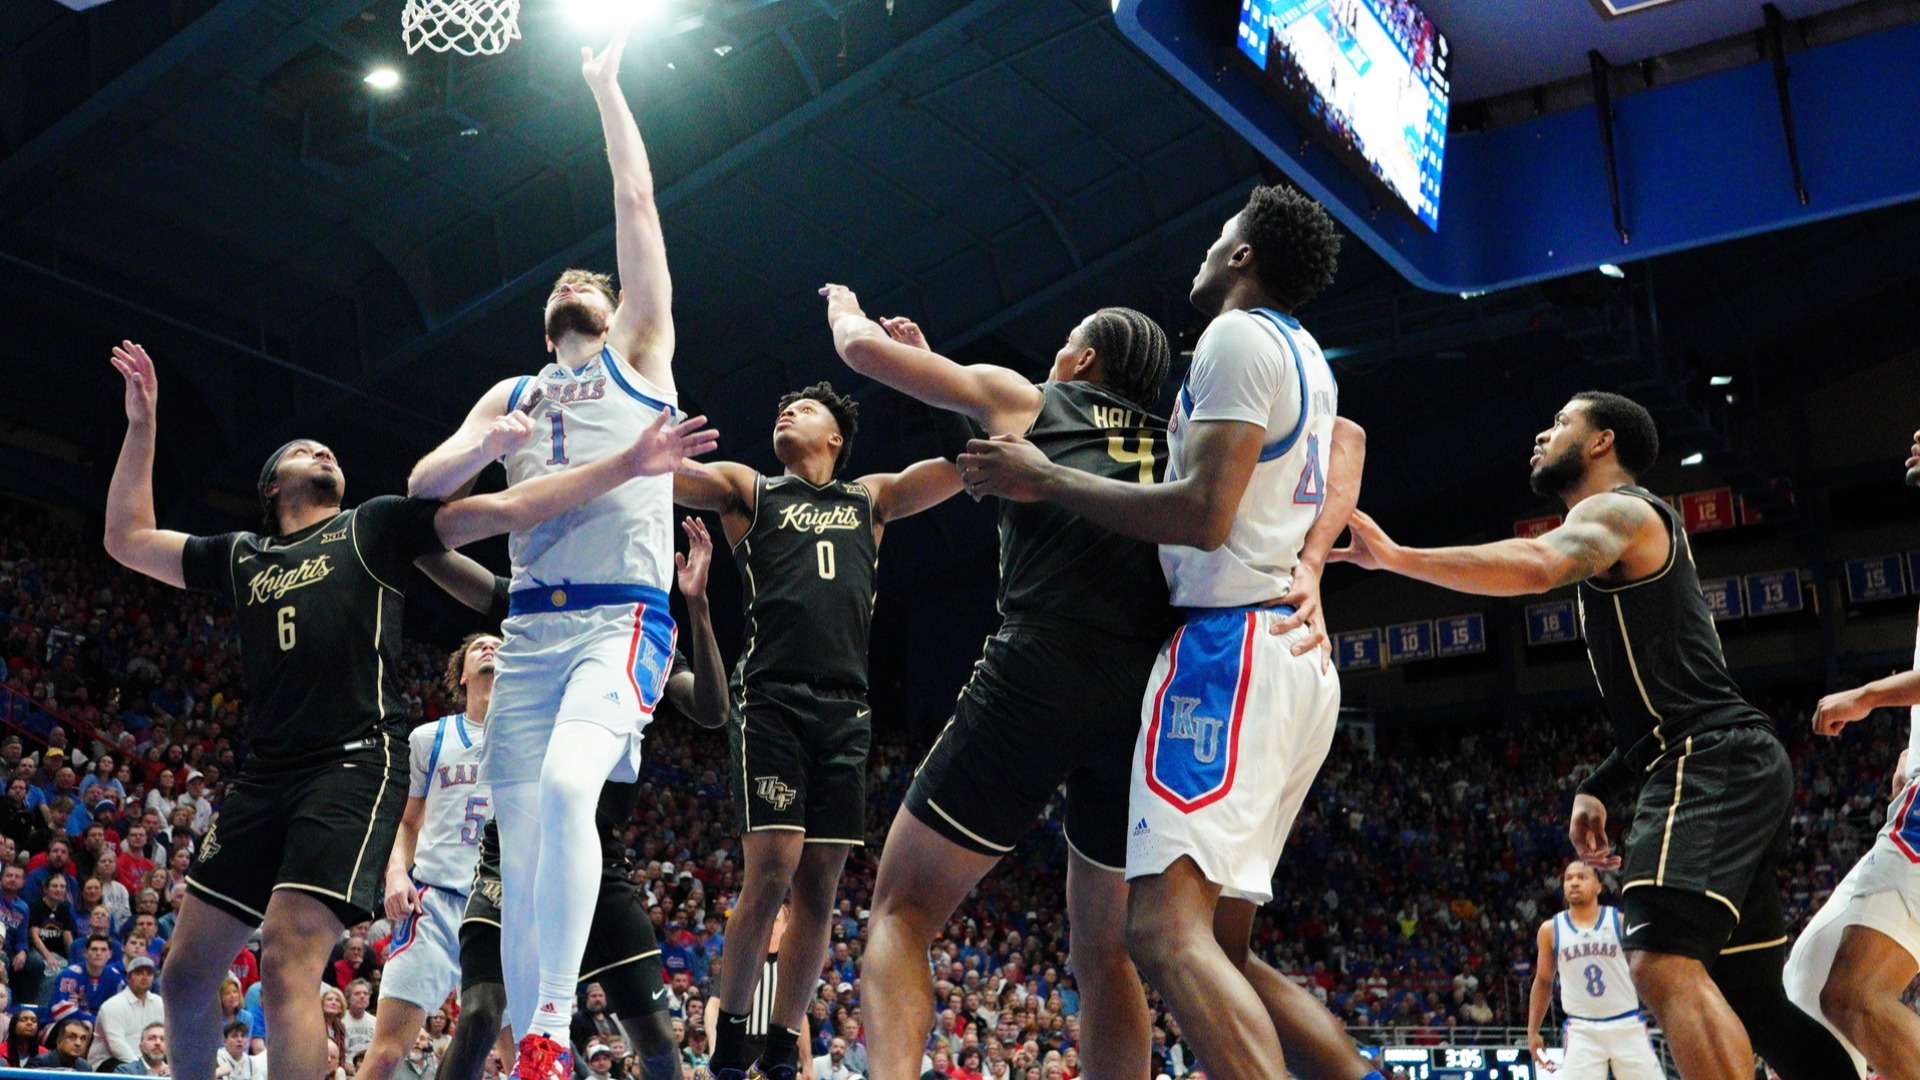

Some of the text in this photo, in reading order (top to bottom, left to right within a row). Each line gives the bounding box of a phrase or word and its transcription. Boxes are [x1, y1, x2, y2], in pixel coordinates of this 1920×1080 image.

[545, 410, 569, 466] 1
[1105, 430, 1155, 484] 4
[1293, 432, 1324, 516] 4
[778, 502, 861, 535] Knights
[816, 540, 835, 580] 0
[247, 554, 335, 606] Knights
[277, 605, 296, 651] 6
[1401, 634, 1418, 652] 10
[1452, 627, 1470, 645] 15
[1354, 642, 1364, 659] 5
[1167, 695, 1223, 764] KU
[755, 776, 797, 811] UCF
[461, 796, 489, 846] 5
[1561, 942, 1618, 963] KANSAS
[1584, 963, 1606, 997] 8
[1445, 1048, 1482, 1068] 3:05
